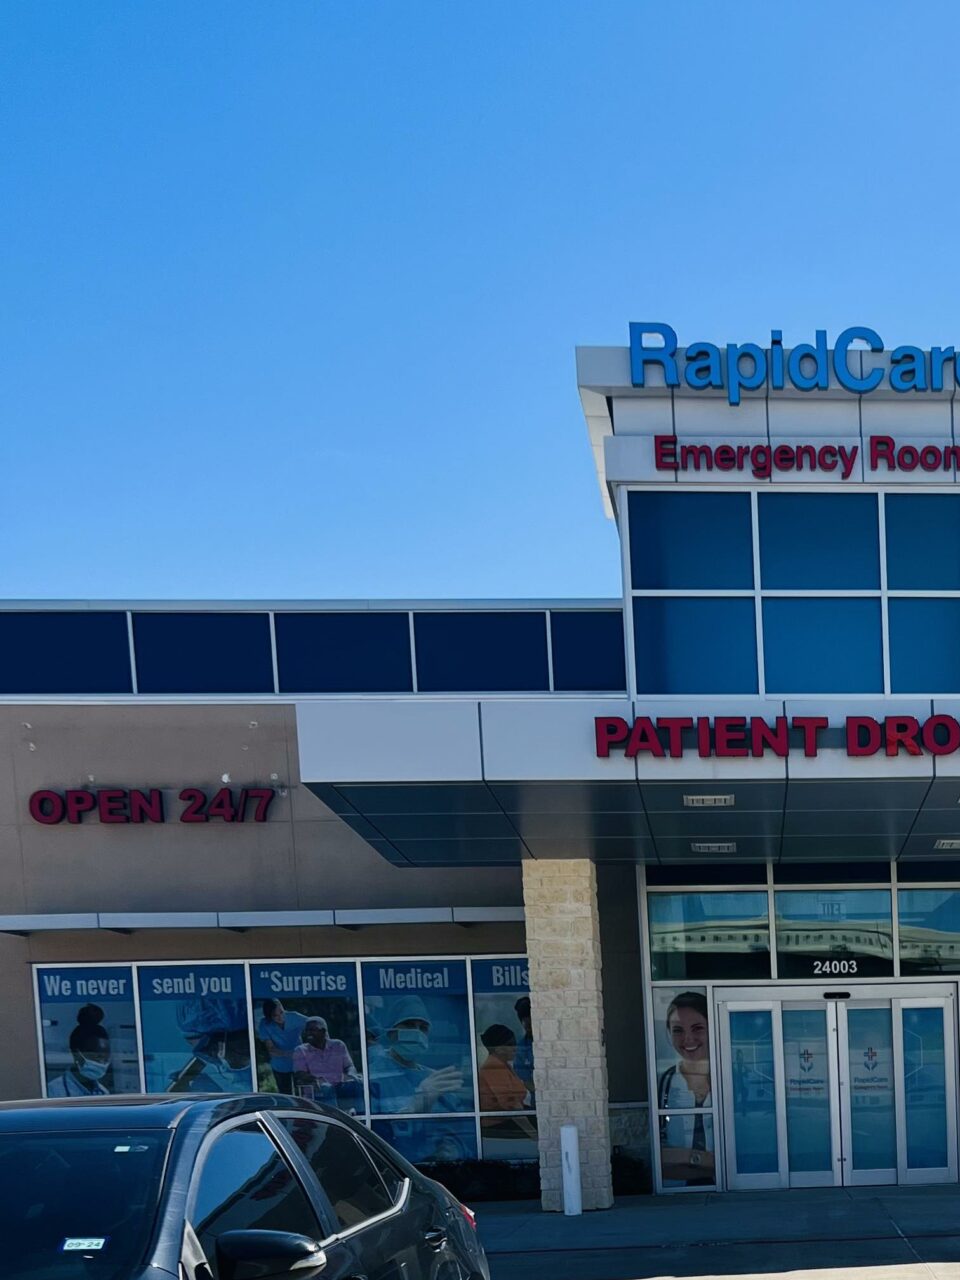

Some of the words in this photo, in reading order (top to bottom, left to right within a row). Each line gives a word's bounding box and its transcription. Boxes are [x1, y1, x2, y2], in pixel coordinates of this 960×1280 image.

[654, 435, 859, 480] Emergency
[594, 716, 829, 758] PATIENT
[29, 788, 165, 824] OPEN
[179, 787, 276, 823] 24/7
[43, 975, 71, 996] We
[76, 978, 127, 995] never
[152, 973, 195, 994] send
[200, 977, 232, 996] you
[379, 968, 449, 989] Medical
[813, 960, 858, 974] 24003
